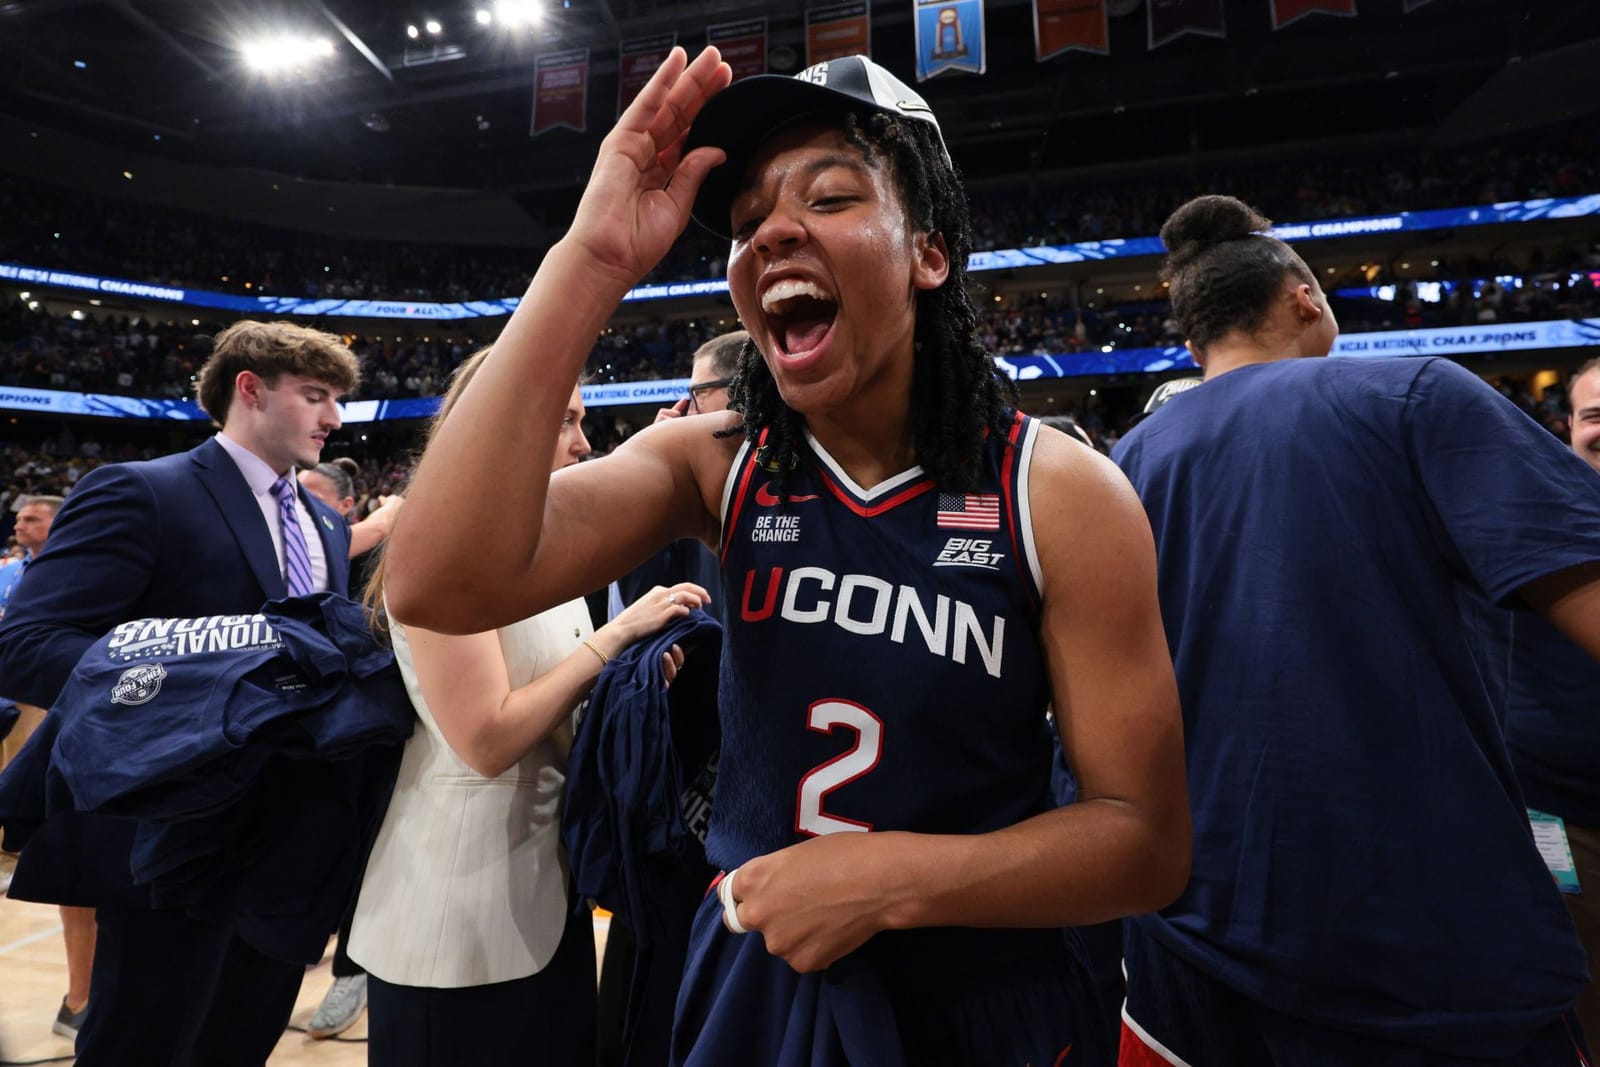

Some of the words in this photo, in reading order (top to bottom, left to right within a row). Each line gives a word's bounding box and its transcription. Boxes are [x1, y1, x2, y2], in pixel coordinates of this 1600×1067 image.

[793, 62, 829, 86] NS
[1311, 217, 1402, 236] CHAMPIONS
[100, 280, 184, 300] CHAMPIONS
[1432, 331, 1537, 347] CHAMPIONS
[755, 515, 773, 529] BE
[775, 515, 801, 529] THE
[751, 528, 801, 542] CHANGE
[943, 537, 993, 553] BIG
[936, 549, 1006, 566] EAST
[740, 566, 1006, 679] UCONN
[172, 621, 284, 657] TIONAL
[137, 667, 162, 686] FINAL
[114, 681, 138, 698] FOUR
[794, 697, 885, 836] 2
